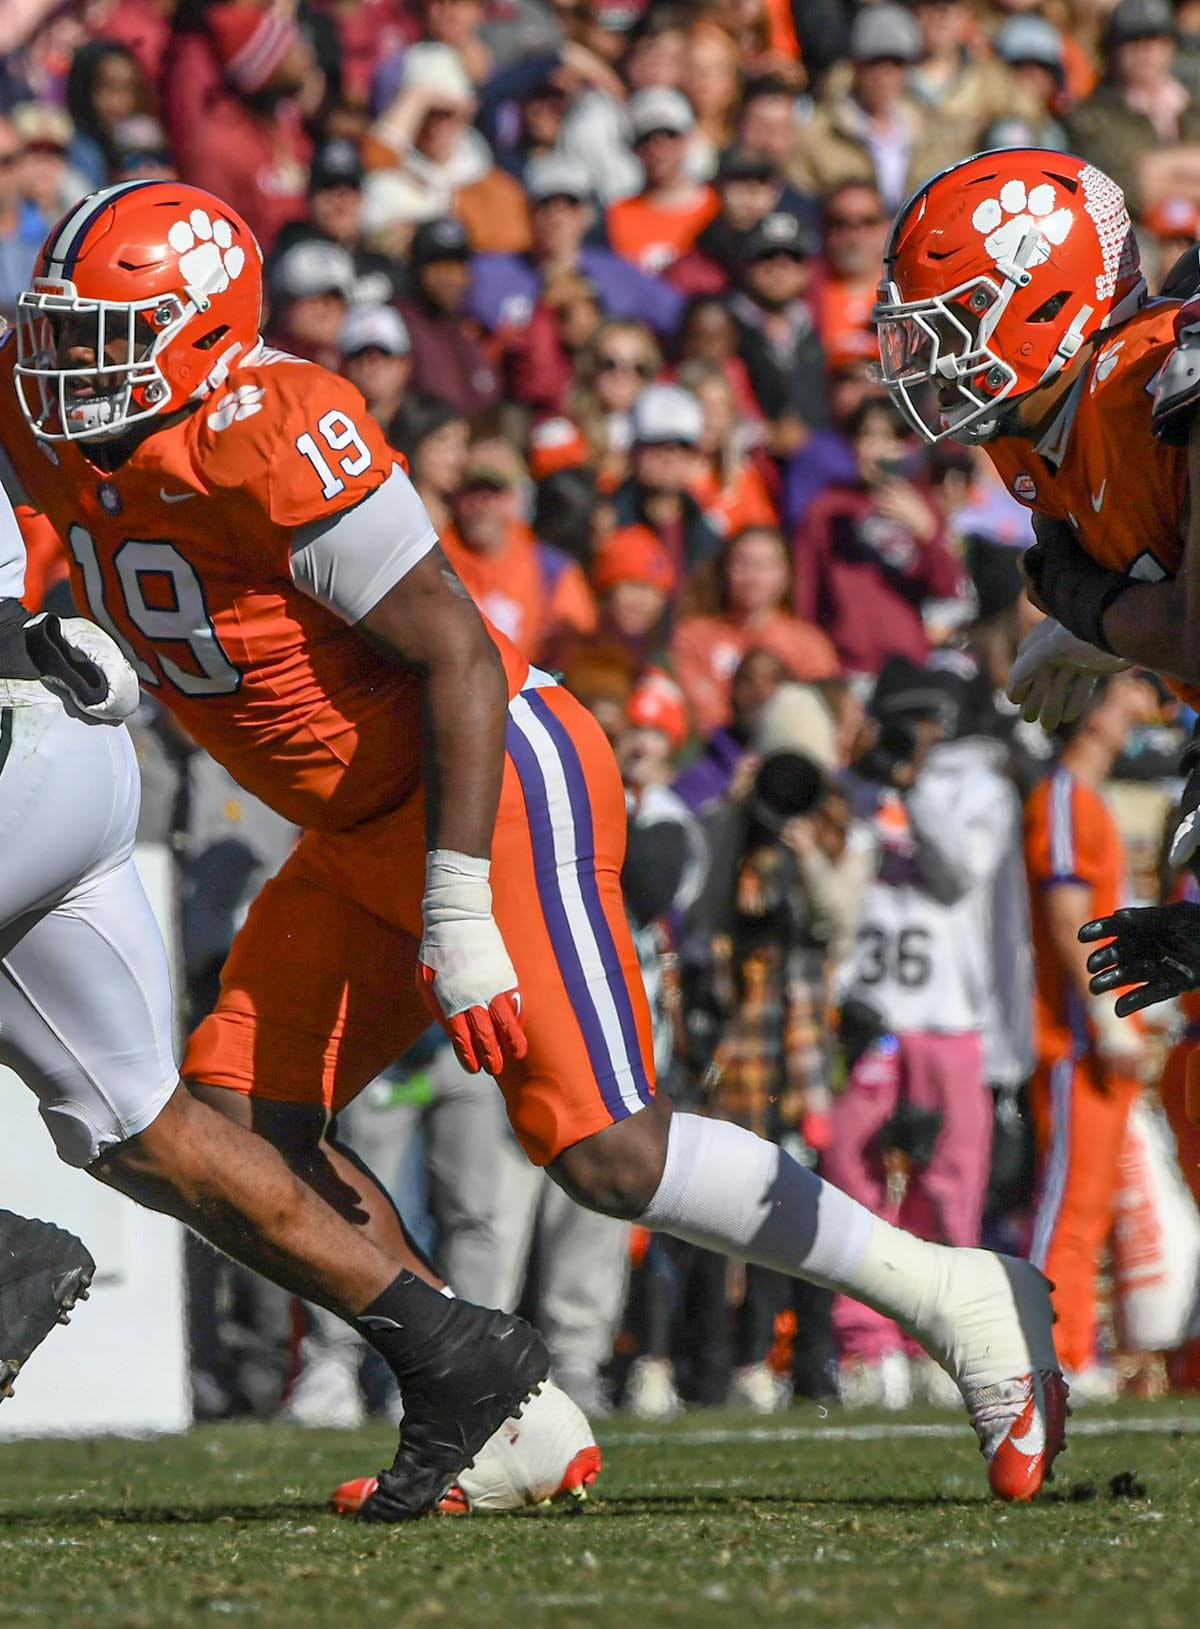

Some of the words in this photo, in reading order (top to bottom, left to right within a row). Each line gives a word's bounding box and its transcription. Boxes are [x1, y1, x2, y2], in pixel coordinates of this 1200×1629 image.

[295, 408, 373, 501] 19
[66, 520, 244, 698] 19
[855, 922, 933, 988] 36
